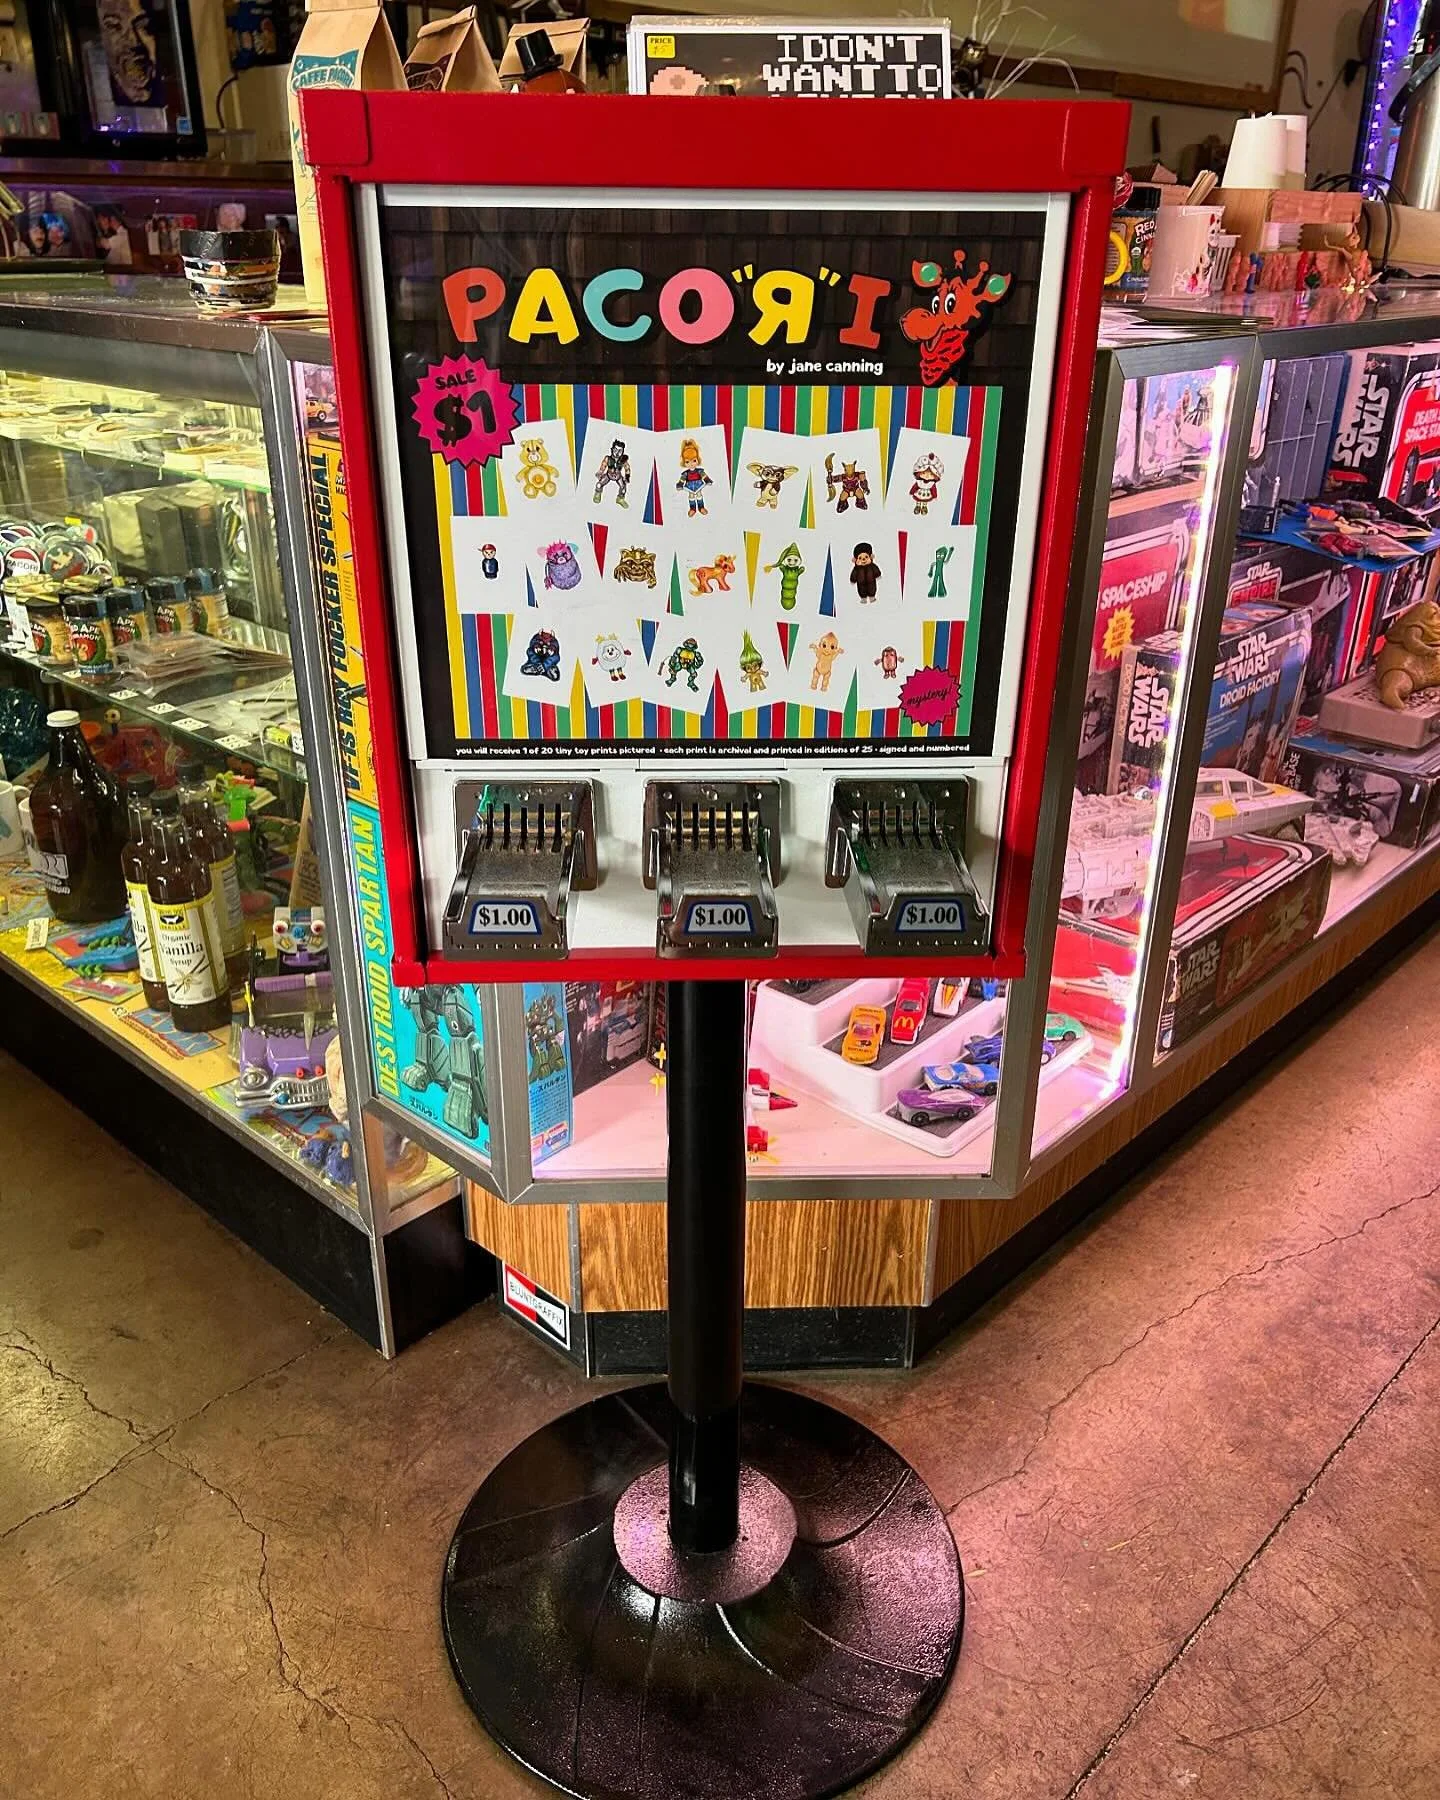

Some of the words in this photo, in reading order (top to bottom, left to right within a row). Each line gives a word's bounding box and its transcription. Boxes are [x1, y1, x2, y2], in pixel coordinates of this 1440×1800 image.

[777, 35, 797, 62] I
[802, 35, 923, 62] DON'T
[762, 64, 880, 92] WANT
[888, 64, 942, 92] TO
[435, 369, 477, 391] SALE
[766, 358, 785, 375] by
[789, 358, 822, 375] jane
[826, 359, 884, 375] canning
[434, 390, 497, 447] $1
[1351, 374, 1390, 468] STAR
[311, 453, 338, 567] SPECIAL
[1247, 562, 1271, 579] STAR
[1101, 571, 1168, 610] SPACESHIP
[323, 569, 348, 672] FOCKER
[1238, 632, 1269, 658] STAR
[1233, 649, 1275, 684] WARS
[1220, 683, 1247, 708] DROID
[1247, 670, 1281, 696] FACTORY
[1128, 676, 1153, 747] WARS
[1145, 677, 1169, 748] STAR
[456, 748, 472, 757] you
[474, 746, 488, 755] will
[490, 746, 520, 755] receive
[528, 747, 540, 755] of
[541, 747, 553, 755] 20
[555, 746, 572, 756] tiny
[574, 746, 589, 756] toy
[591, 746, 618, 756] prints
[619, 746, 656, 756] pictured
[664, 746, 685, 755] each
[686, 746, 708, 756] print
[708, 746, 717, 754] is
[718, 746, 751, 755] archival
[753, 746, 769, 755] and
[771, 746, 802, 756] printed
[804, 745, 812, 754] in
[814, 746, 848, 755] editions
[850, 745, 860, 754] of
[862, 745, 873, 753] 25
[880, 744, 907, 755] signed
[908, 744, 925, 753] and
[926, 744, 970, 753] numbered
[352, 816, 387, 957] SPARTAN
[478, 907, 532, 928] $1.00
[694, 906, 746, 928] $1.00
[906, 906, 958, 927] $1.00
[160, 941, 204, 956] Vanilla
[170, 957, 192, 966] Syrup
[1186, 940, 1220, 974] STAR
[1181, 956, 1220, 995] WARS
[369, 962, 400, 1097] DESTROID
